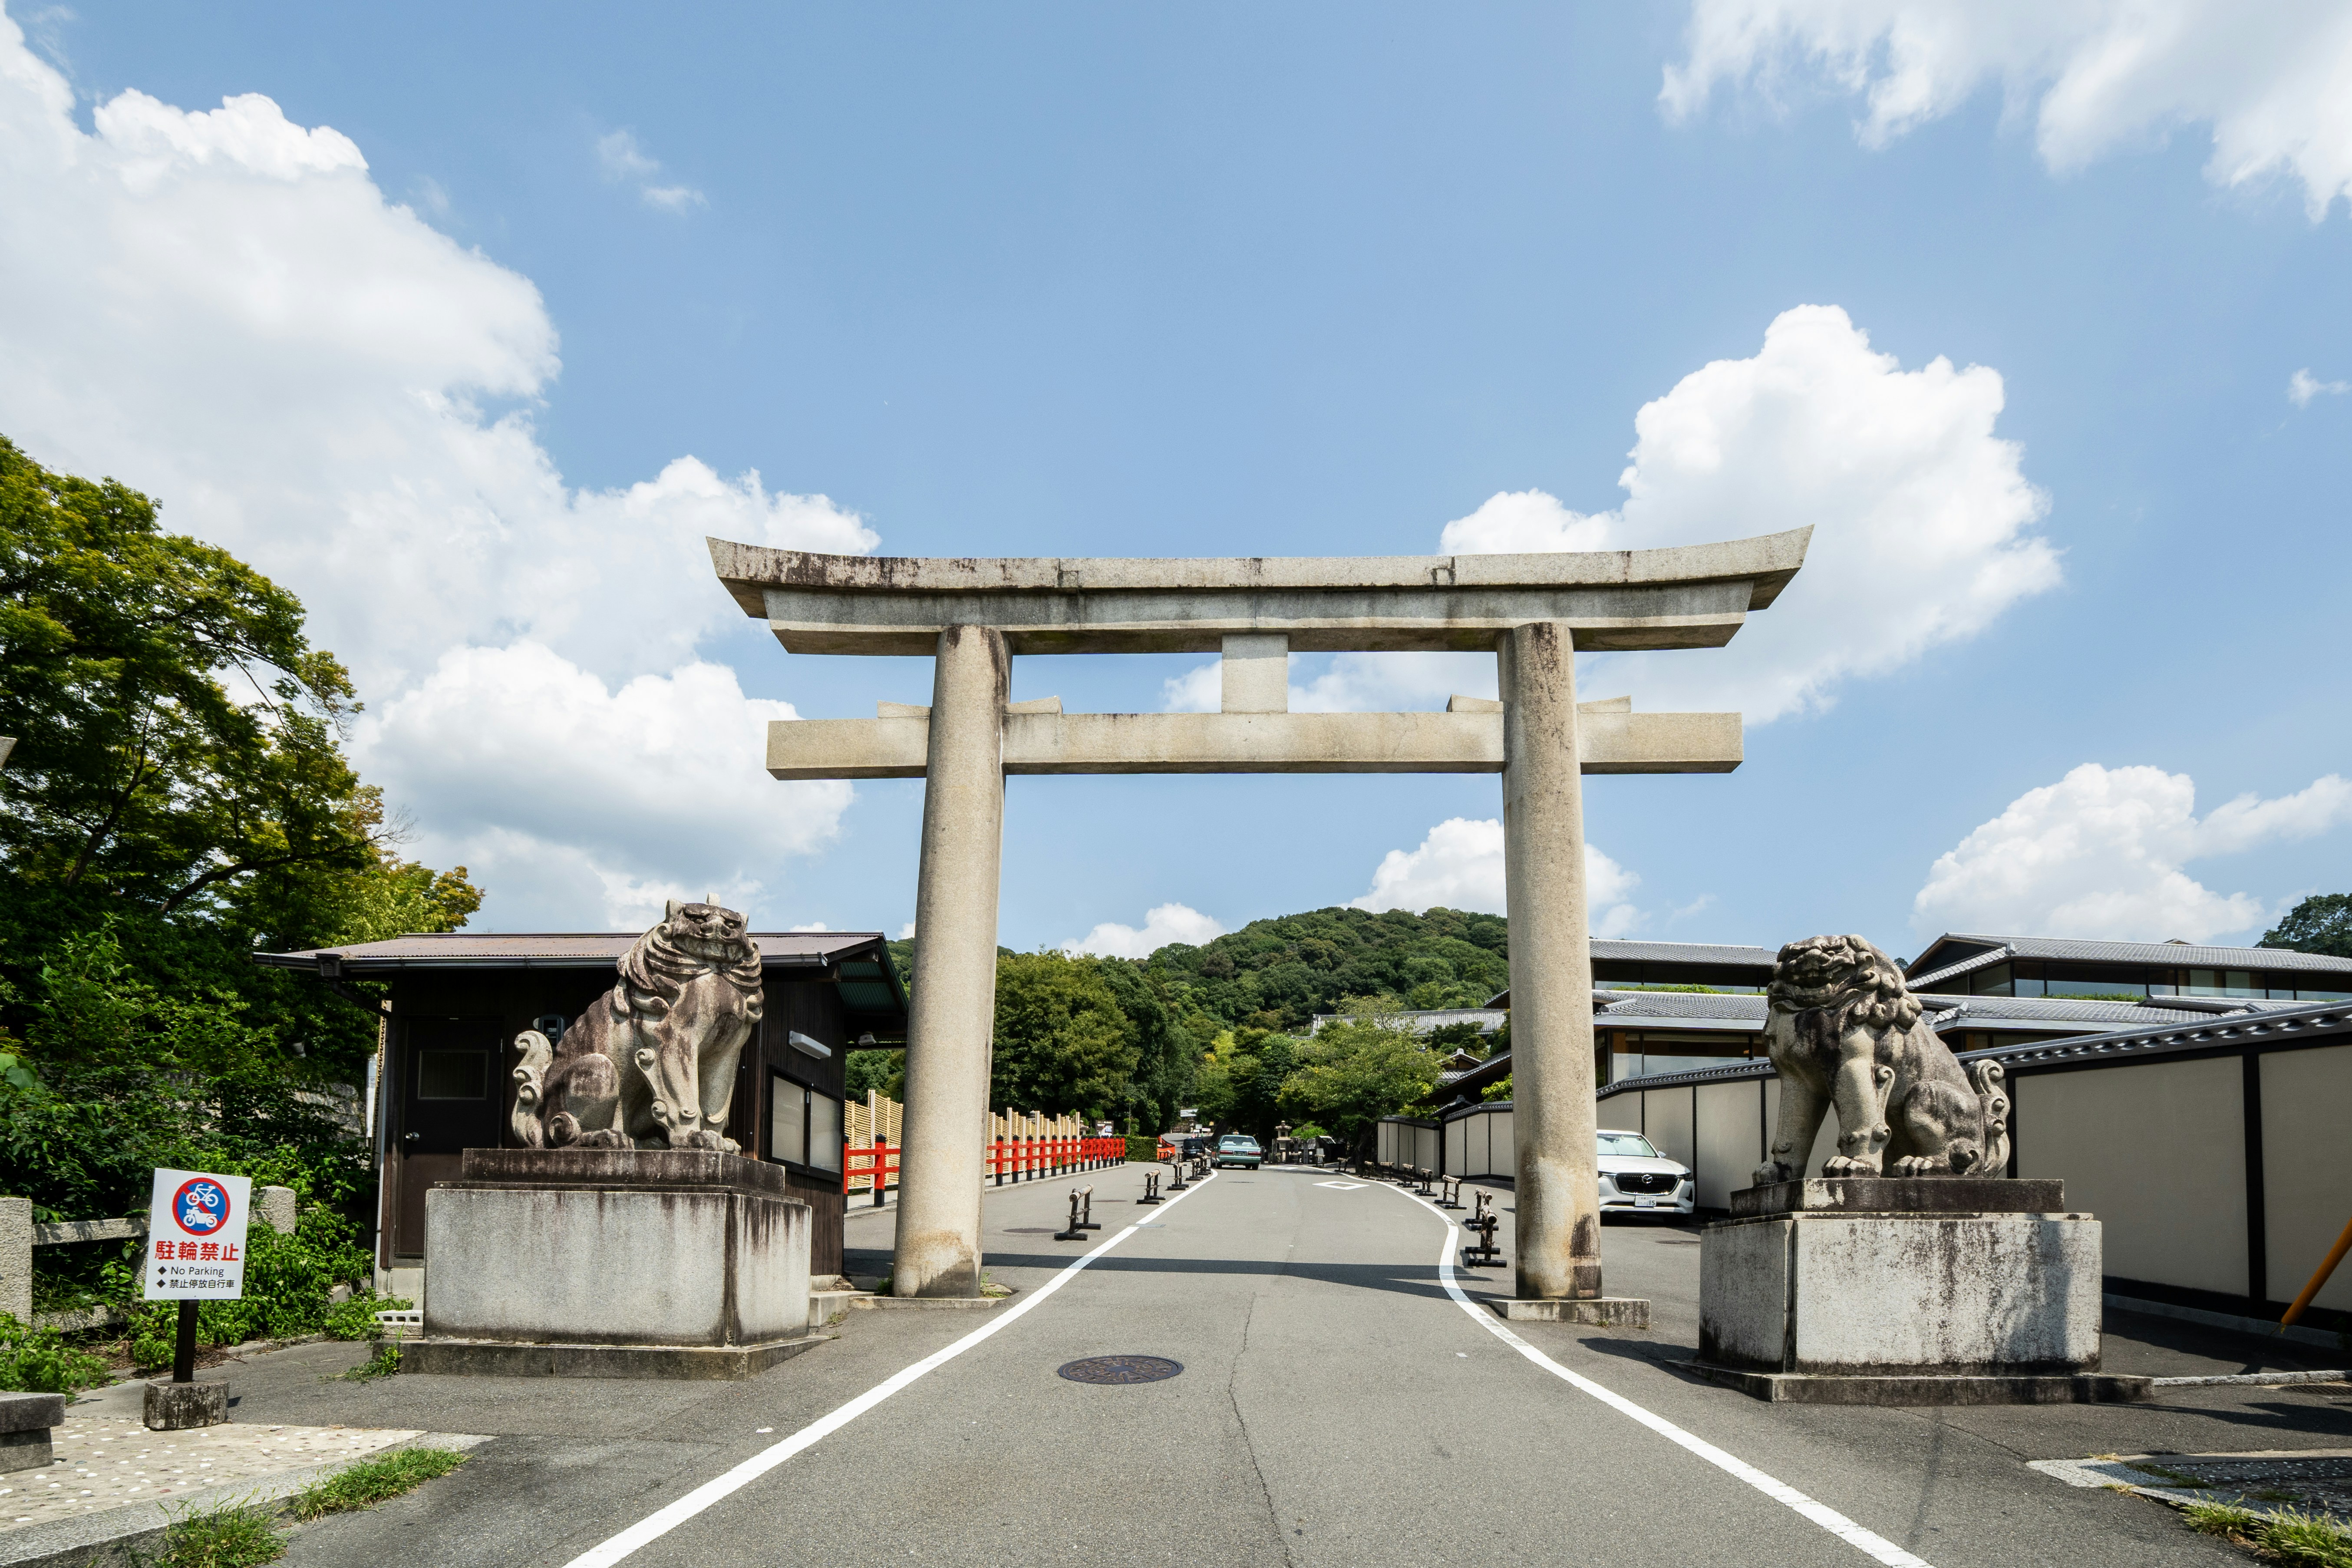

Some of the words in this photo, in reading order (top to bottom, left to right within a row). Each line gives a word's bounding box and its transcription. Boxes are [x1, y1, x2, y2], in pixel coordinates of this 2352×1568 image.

[155, 1241, 239, 1261] 駐輪禁止
[171, 1266, 185, 1275] No
[189, 1267, 224, 1278] Parking
[169, 1279, 235, 1288] 禁止停放自行車
